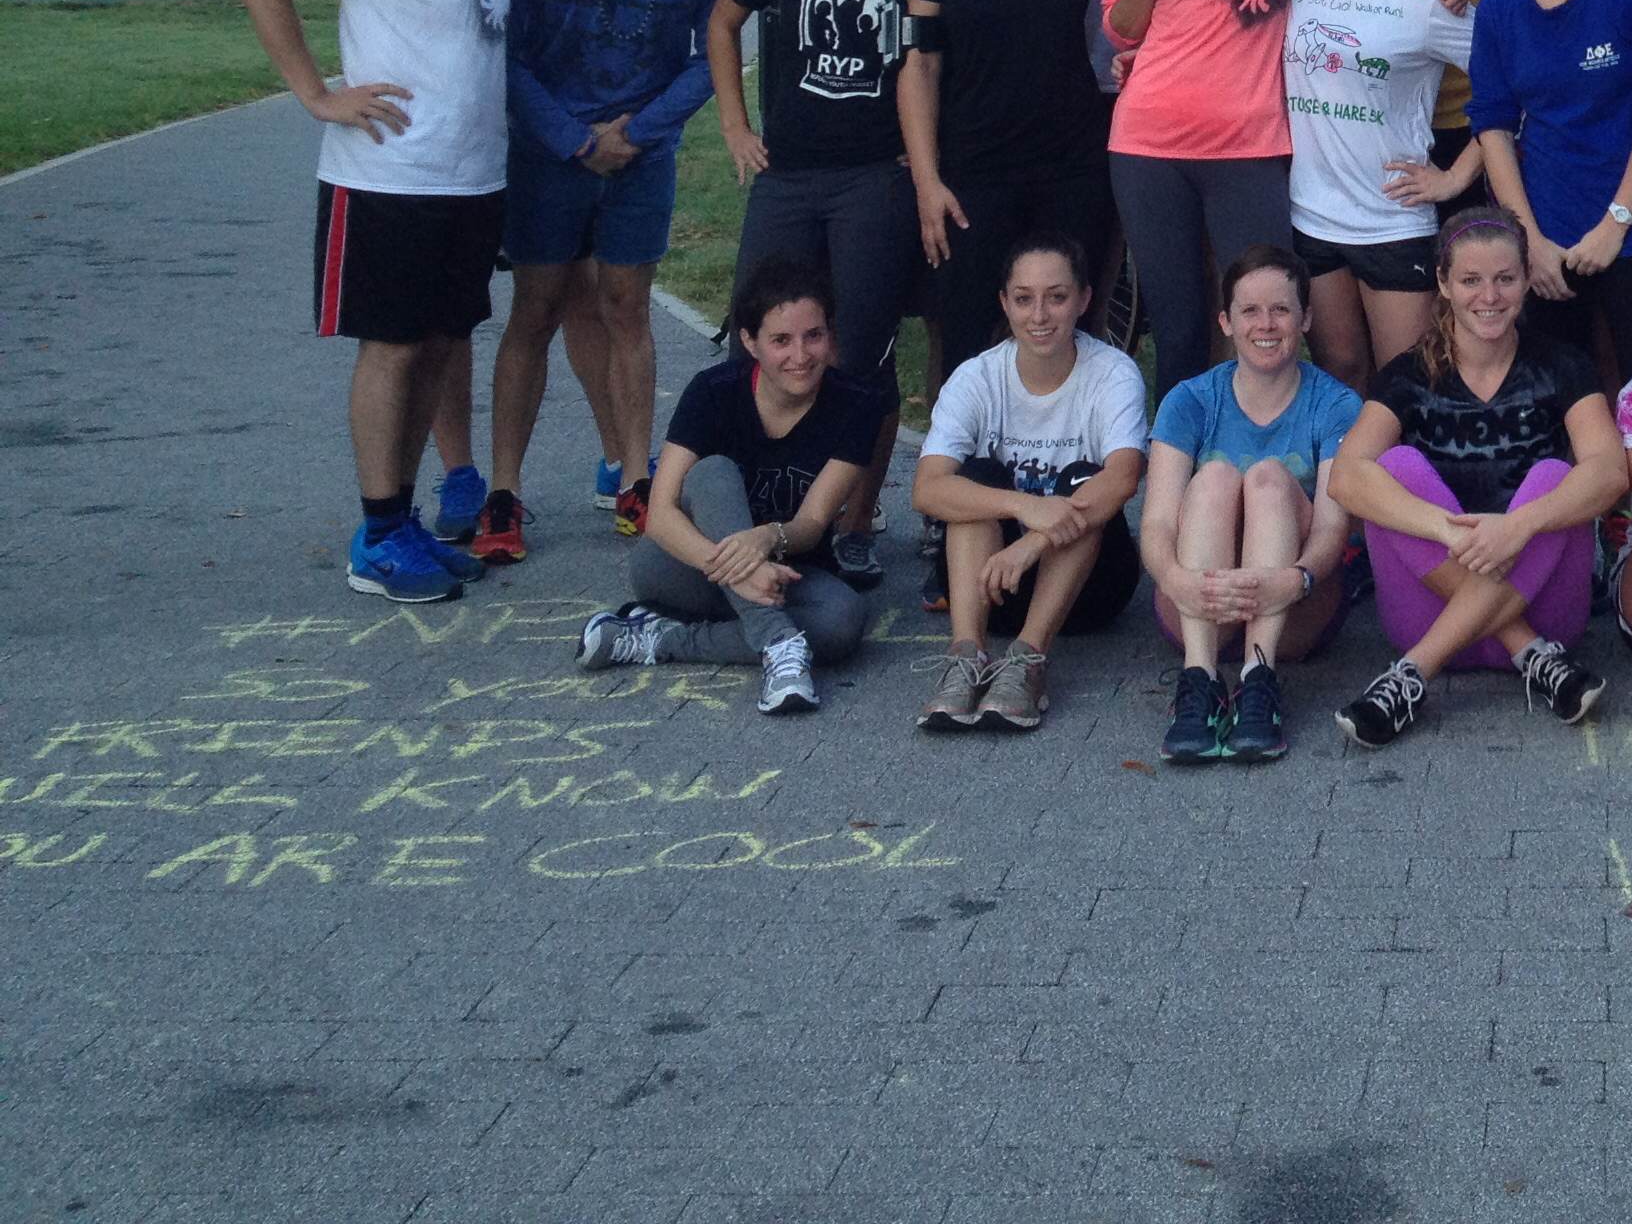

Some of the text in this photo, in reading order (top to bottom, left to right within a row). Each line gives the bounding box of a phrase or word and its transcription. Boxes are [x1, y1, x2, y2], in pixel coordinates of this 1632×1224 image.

[818, 54, 864, 76] RYP
[1334, 103, 1367, 122] HARE
[33, 719, 659, 765] FRIENDS
[358, 769, 782, 813] KNOW
[145, 831, 487, 886] ARE
[528, 823, 964, 880] COOL
